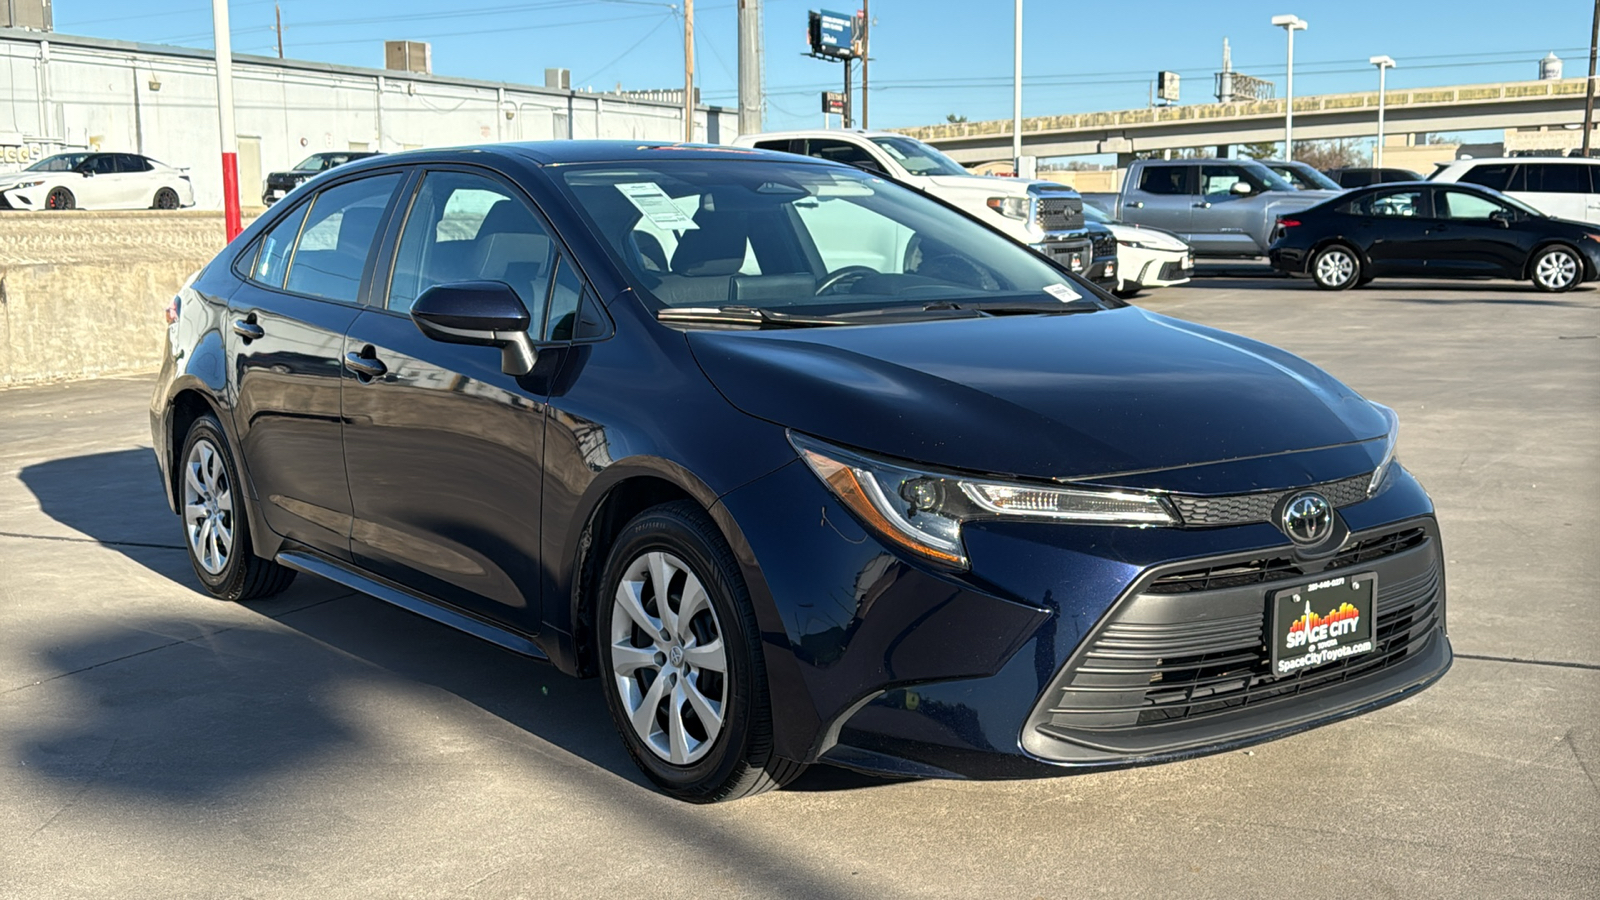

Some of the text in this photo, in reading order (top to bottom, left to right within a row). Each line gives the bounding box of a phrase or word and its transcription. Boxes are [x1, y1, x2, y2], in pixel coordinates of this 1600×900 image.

[1286, 616, 1359, 648] SPACE CITY
[1317, 639, 1338, 650] TOYOTA
[1278, 641, 1372, 672] SpaceCityToyota.com
